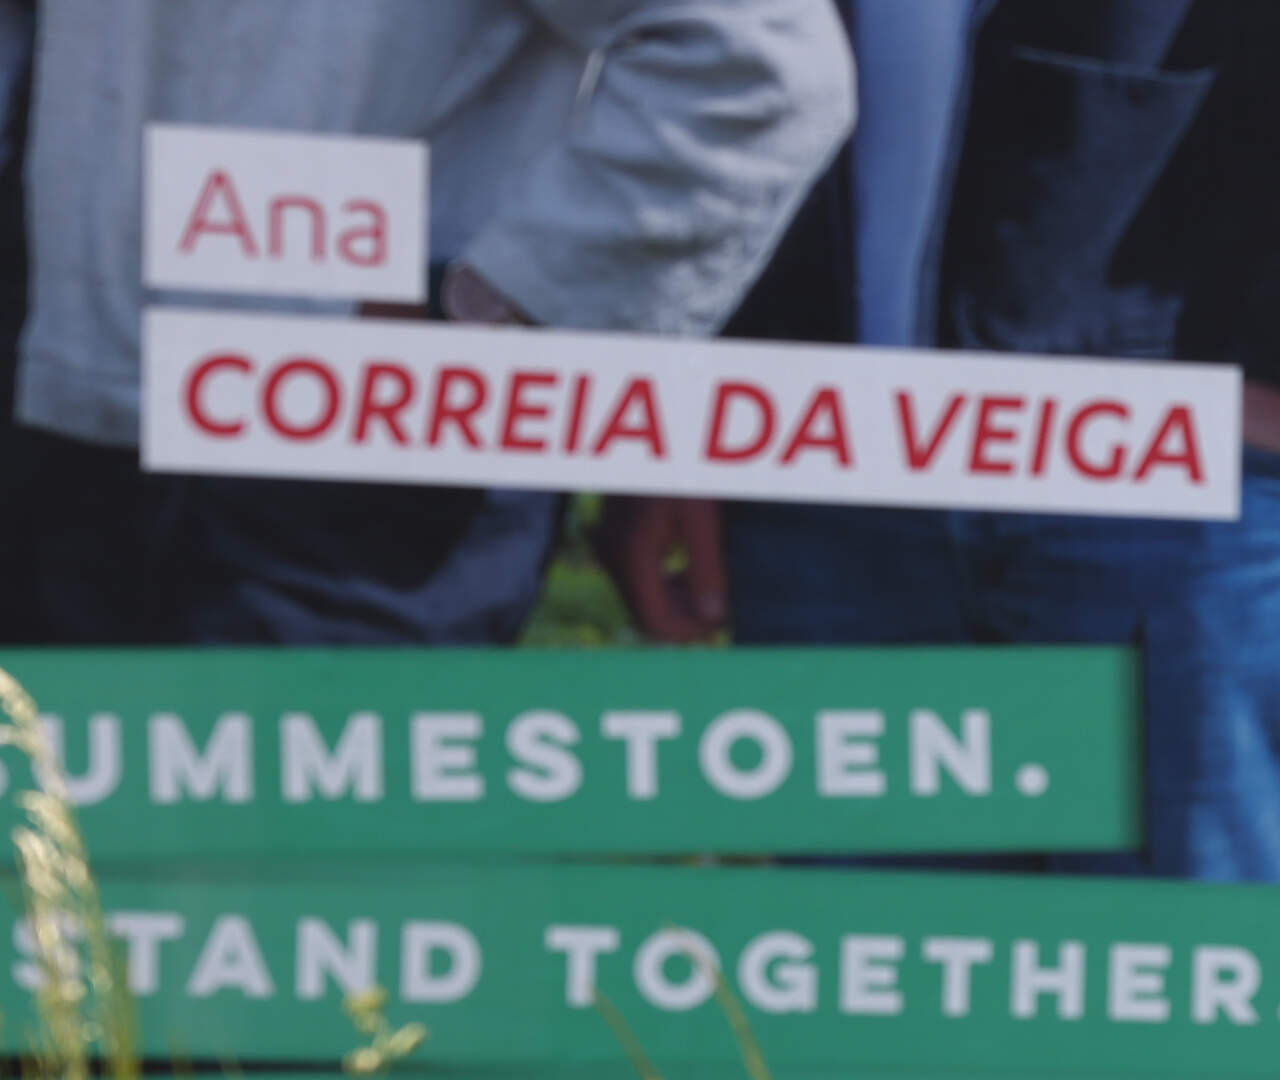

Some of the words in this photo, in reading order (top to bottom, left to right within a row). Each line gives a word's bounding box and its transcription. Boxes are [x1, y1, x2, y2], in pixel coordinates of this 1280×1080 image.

[179, 170, 388, 267] Ana
[183, 354, 665, 459] CORREIA
[704, 381, 854, 468] DA
[895, 389, 1206, 484] VEIGA
[0, 708, 1050, 806] UMMESTOEN.
